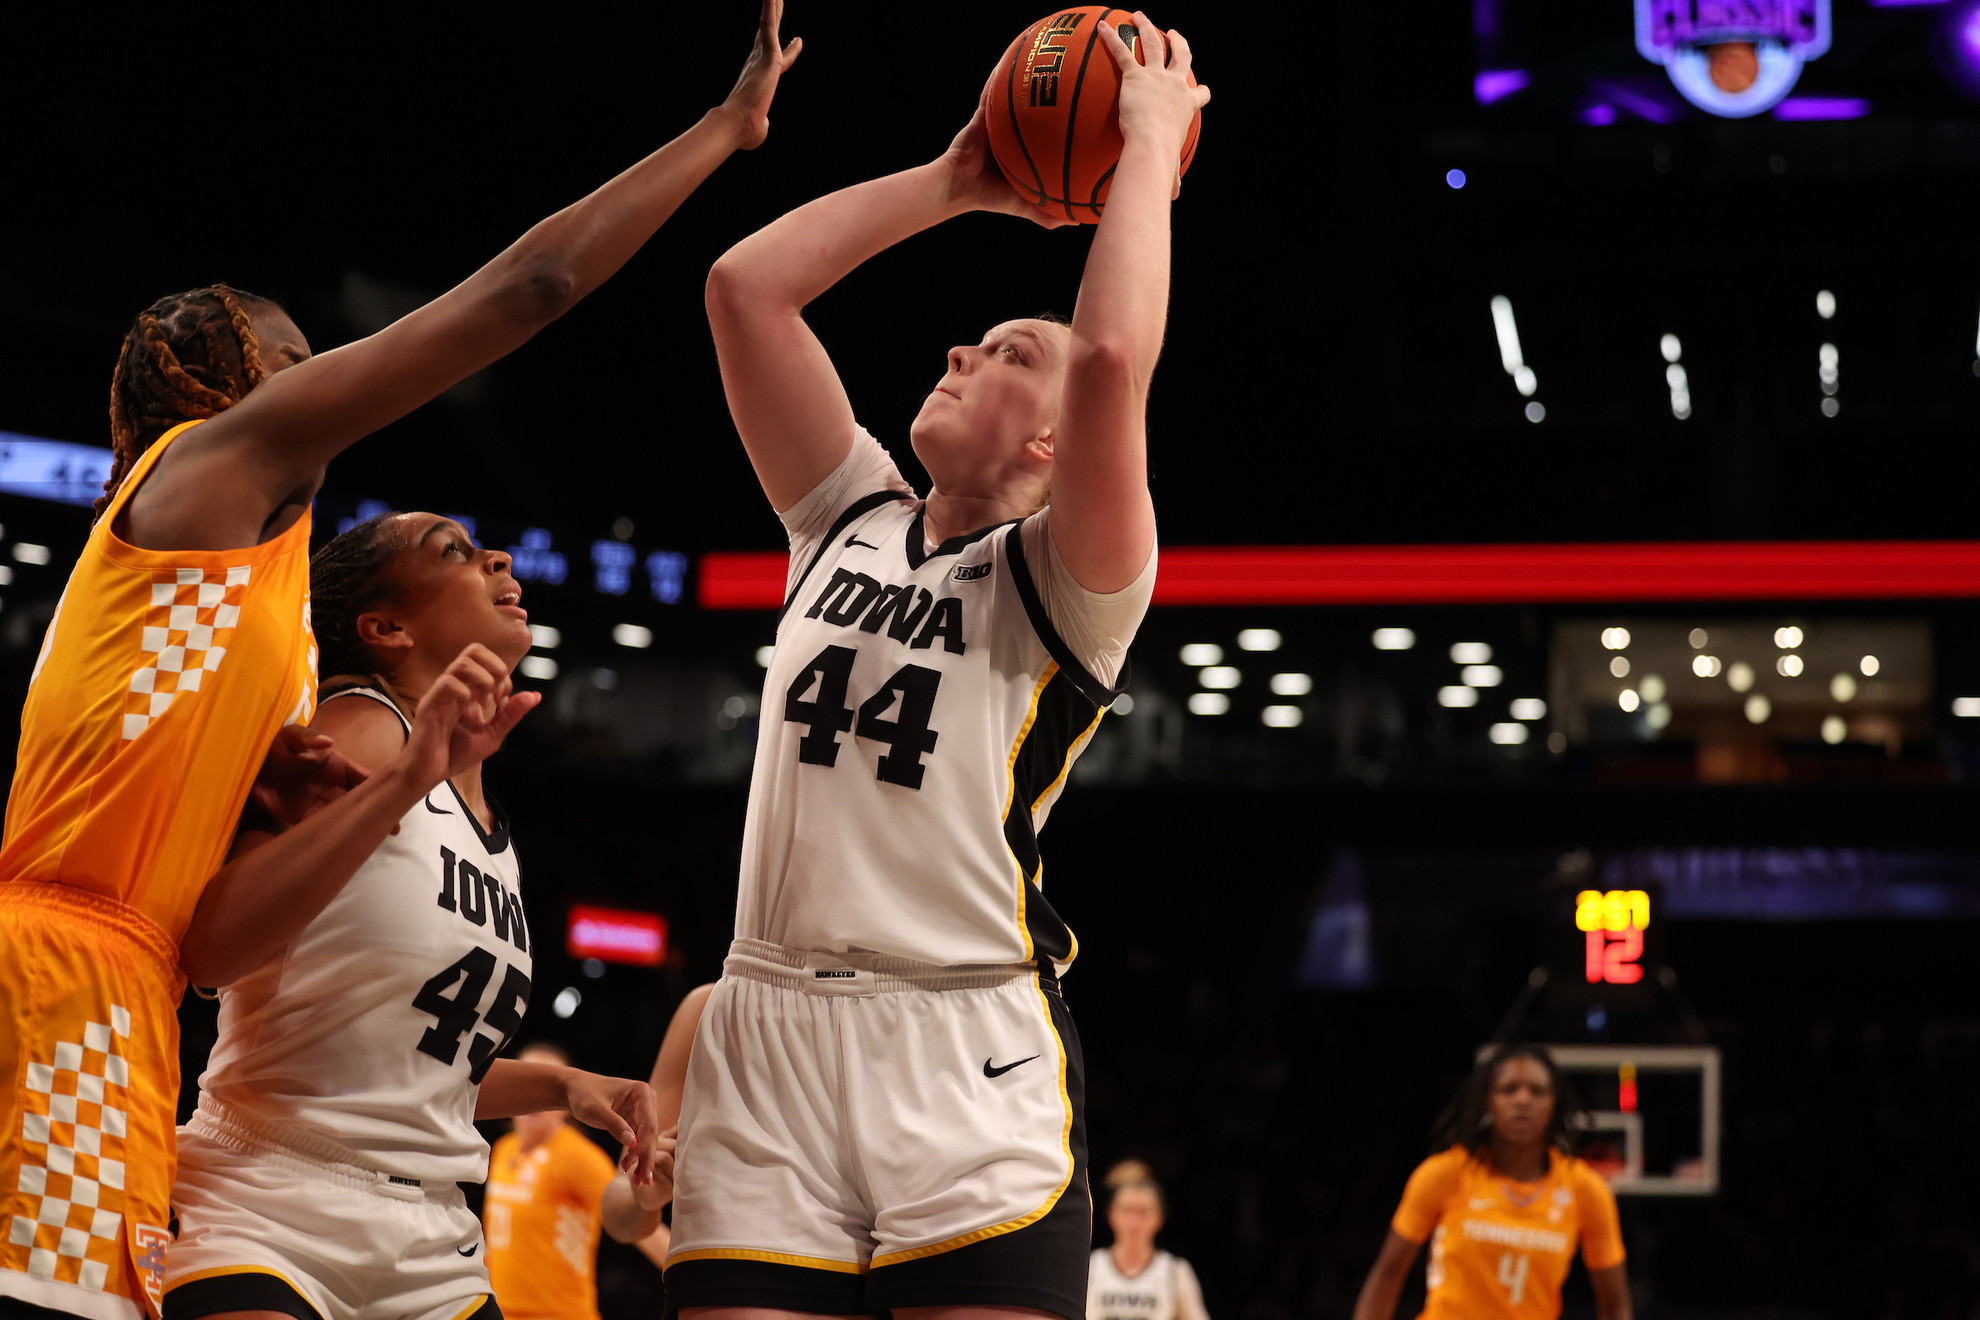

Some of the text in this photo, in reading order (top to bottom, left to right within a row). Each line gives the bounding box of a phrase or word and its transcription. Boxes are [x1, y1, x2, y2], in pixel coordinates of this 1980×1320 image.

[804, 567, 966, 656] IOWA
[784, 644, 942, 790] 44
[438, 845, 532, 958] IOW
[412, 946, 531, 1085] 45
[1498, 1253, 1529, 1306] 4
